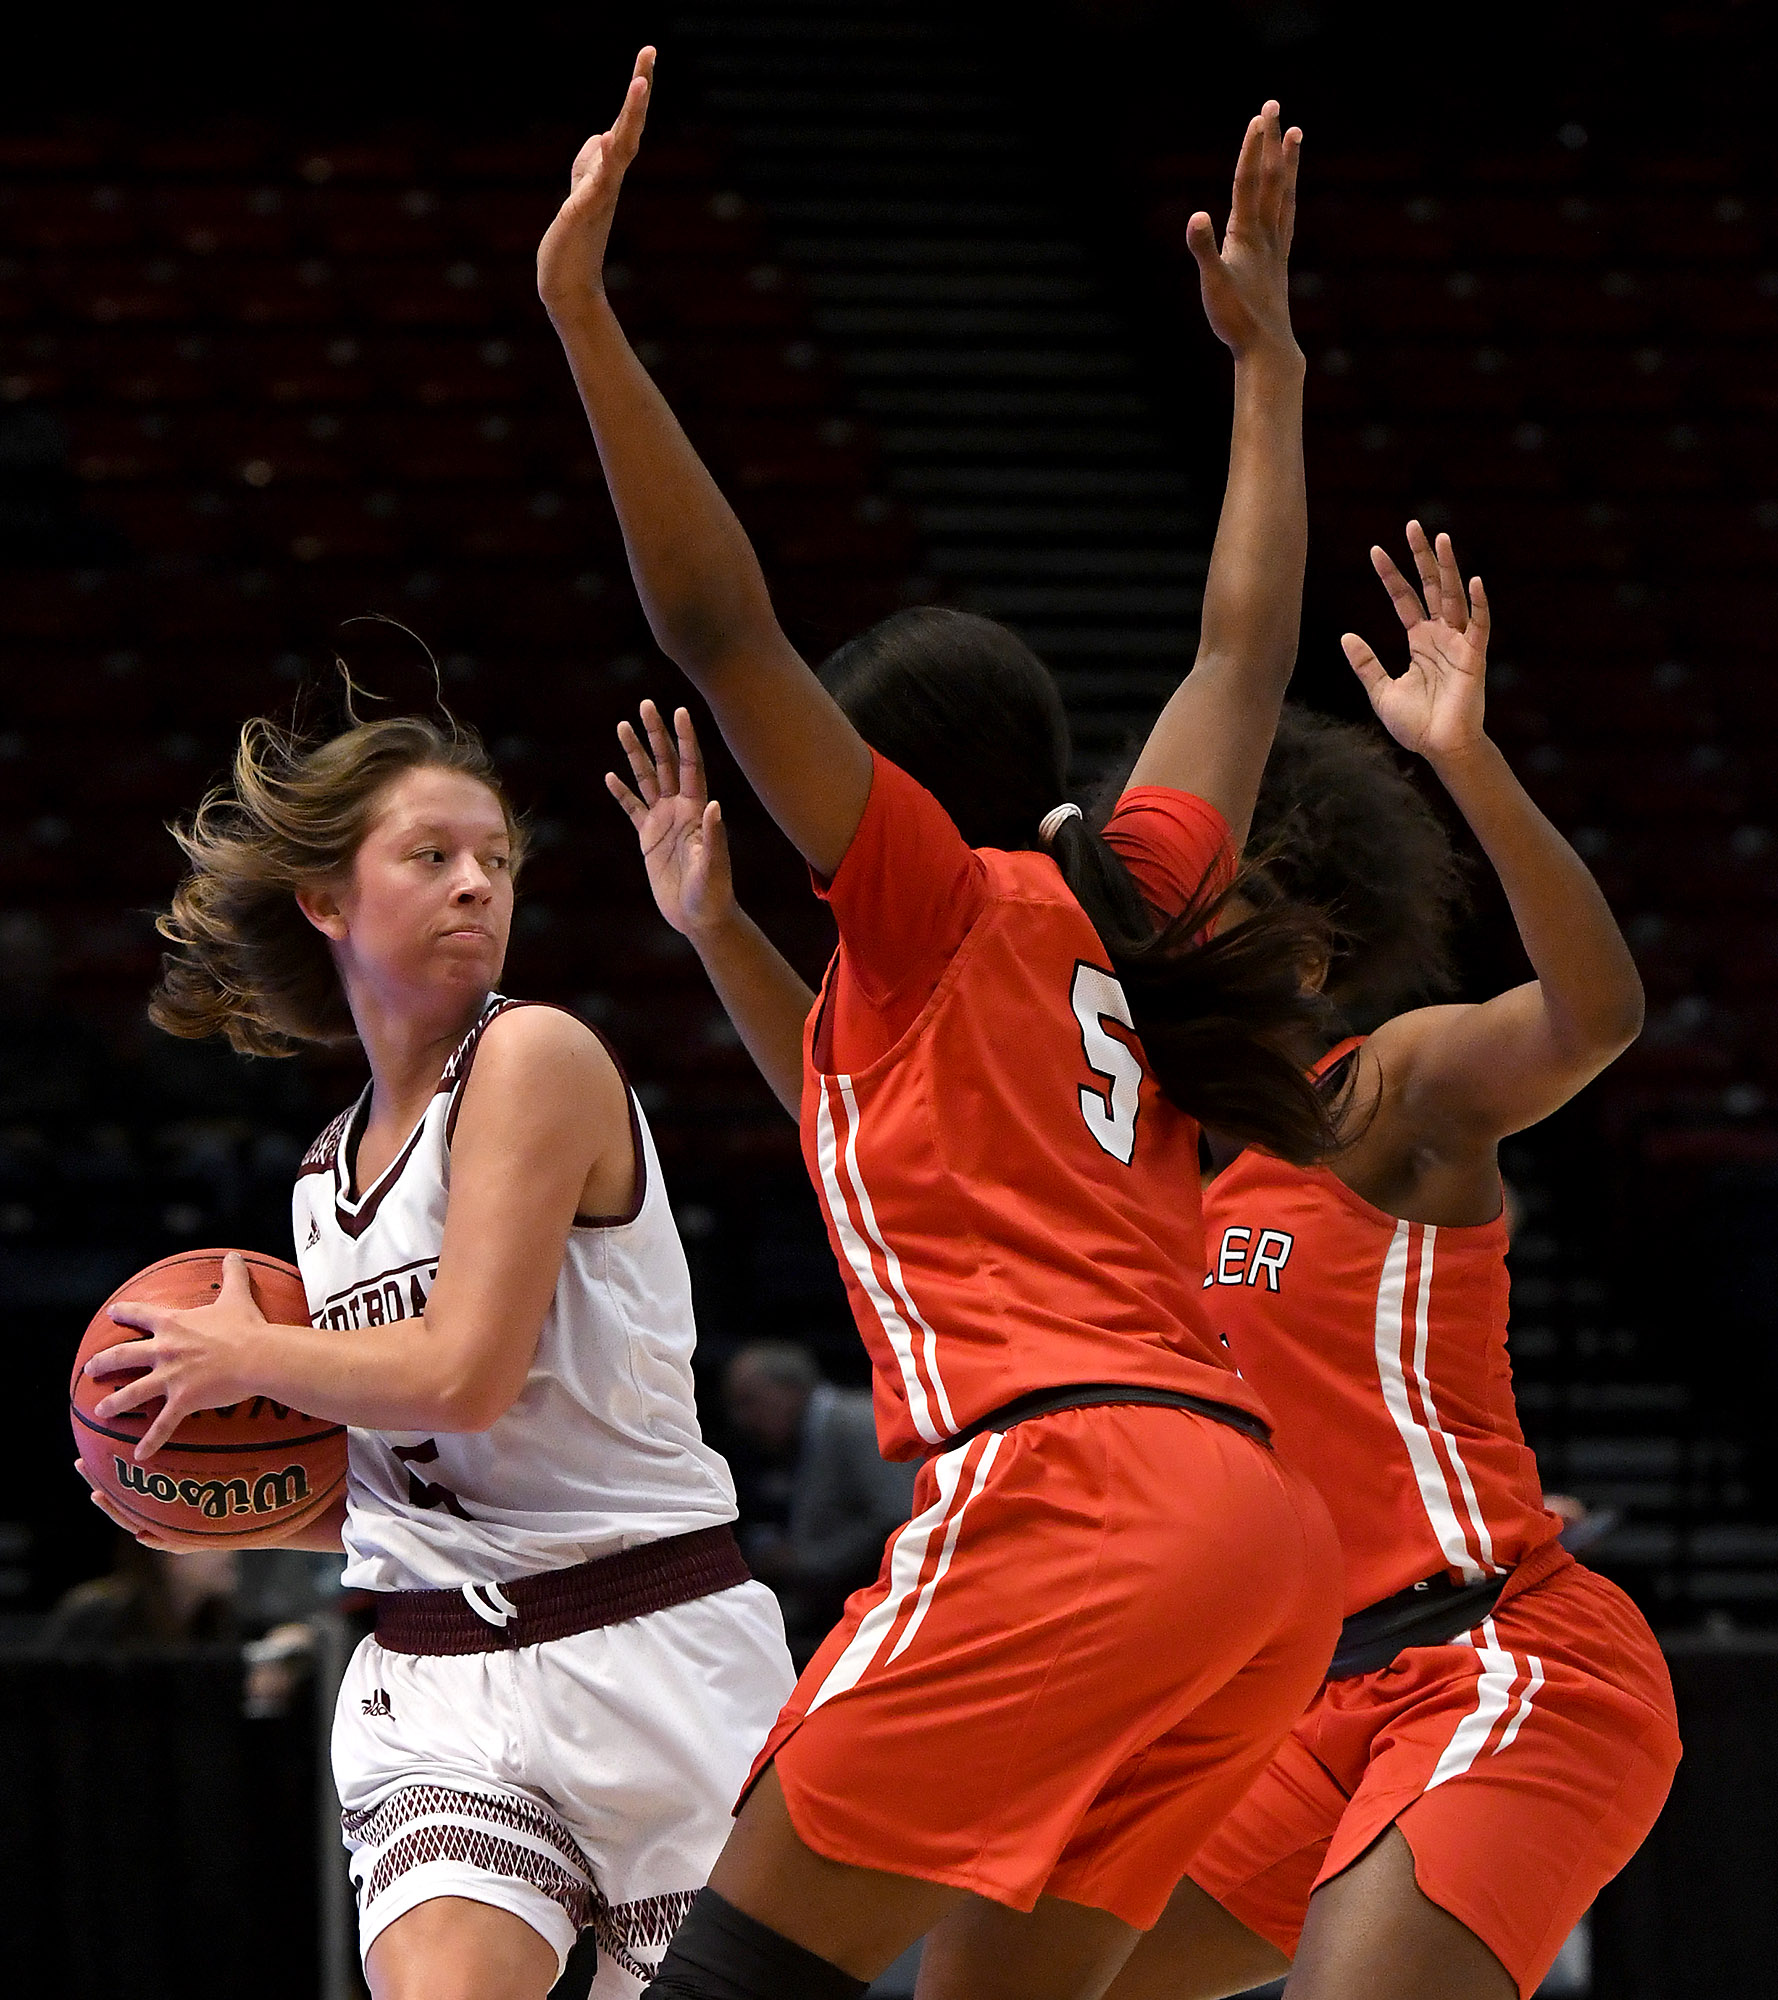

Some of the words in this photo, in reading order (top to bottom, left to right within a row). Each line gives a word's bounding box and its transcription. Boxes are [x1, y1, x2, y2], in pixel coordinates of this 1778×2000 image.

[1069, 958, 1143, 1167] 5
[1202, 1225, 1295, 1294] ER
[113, 1454, 312, 1520] Wilson
